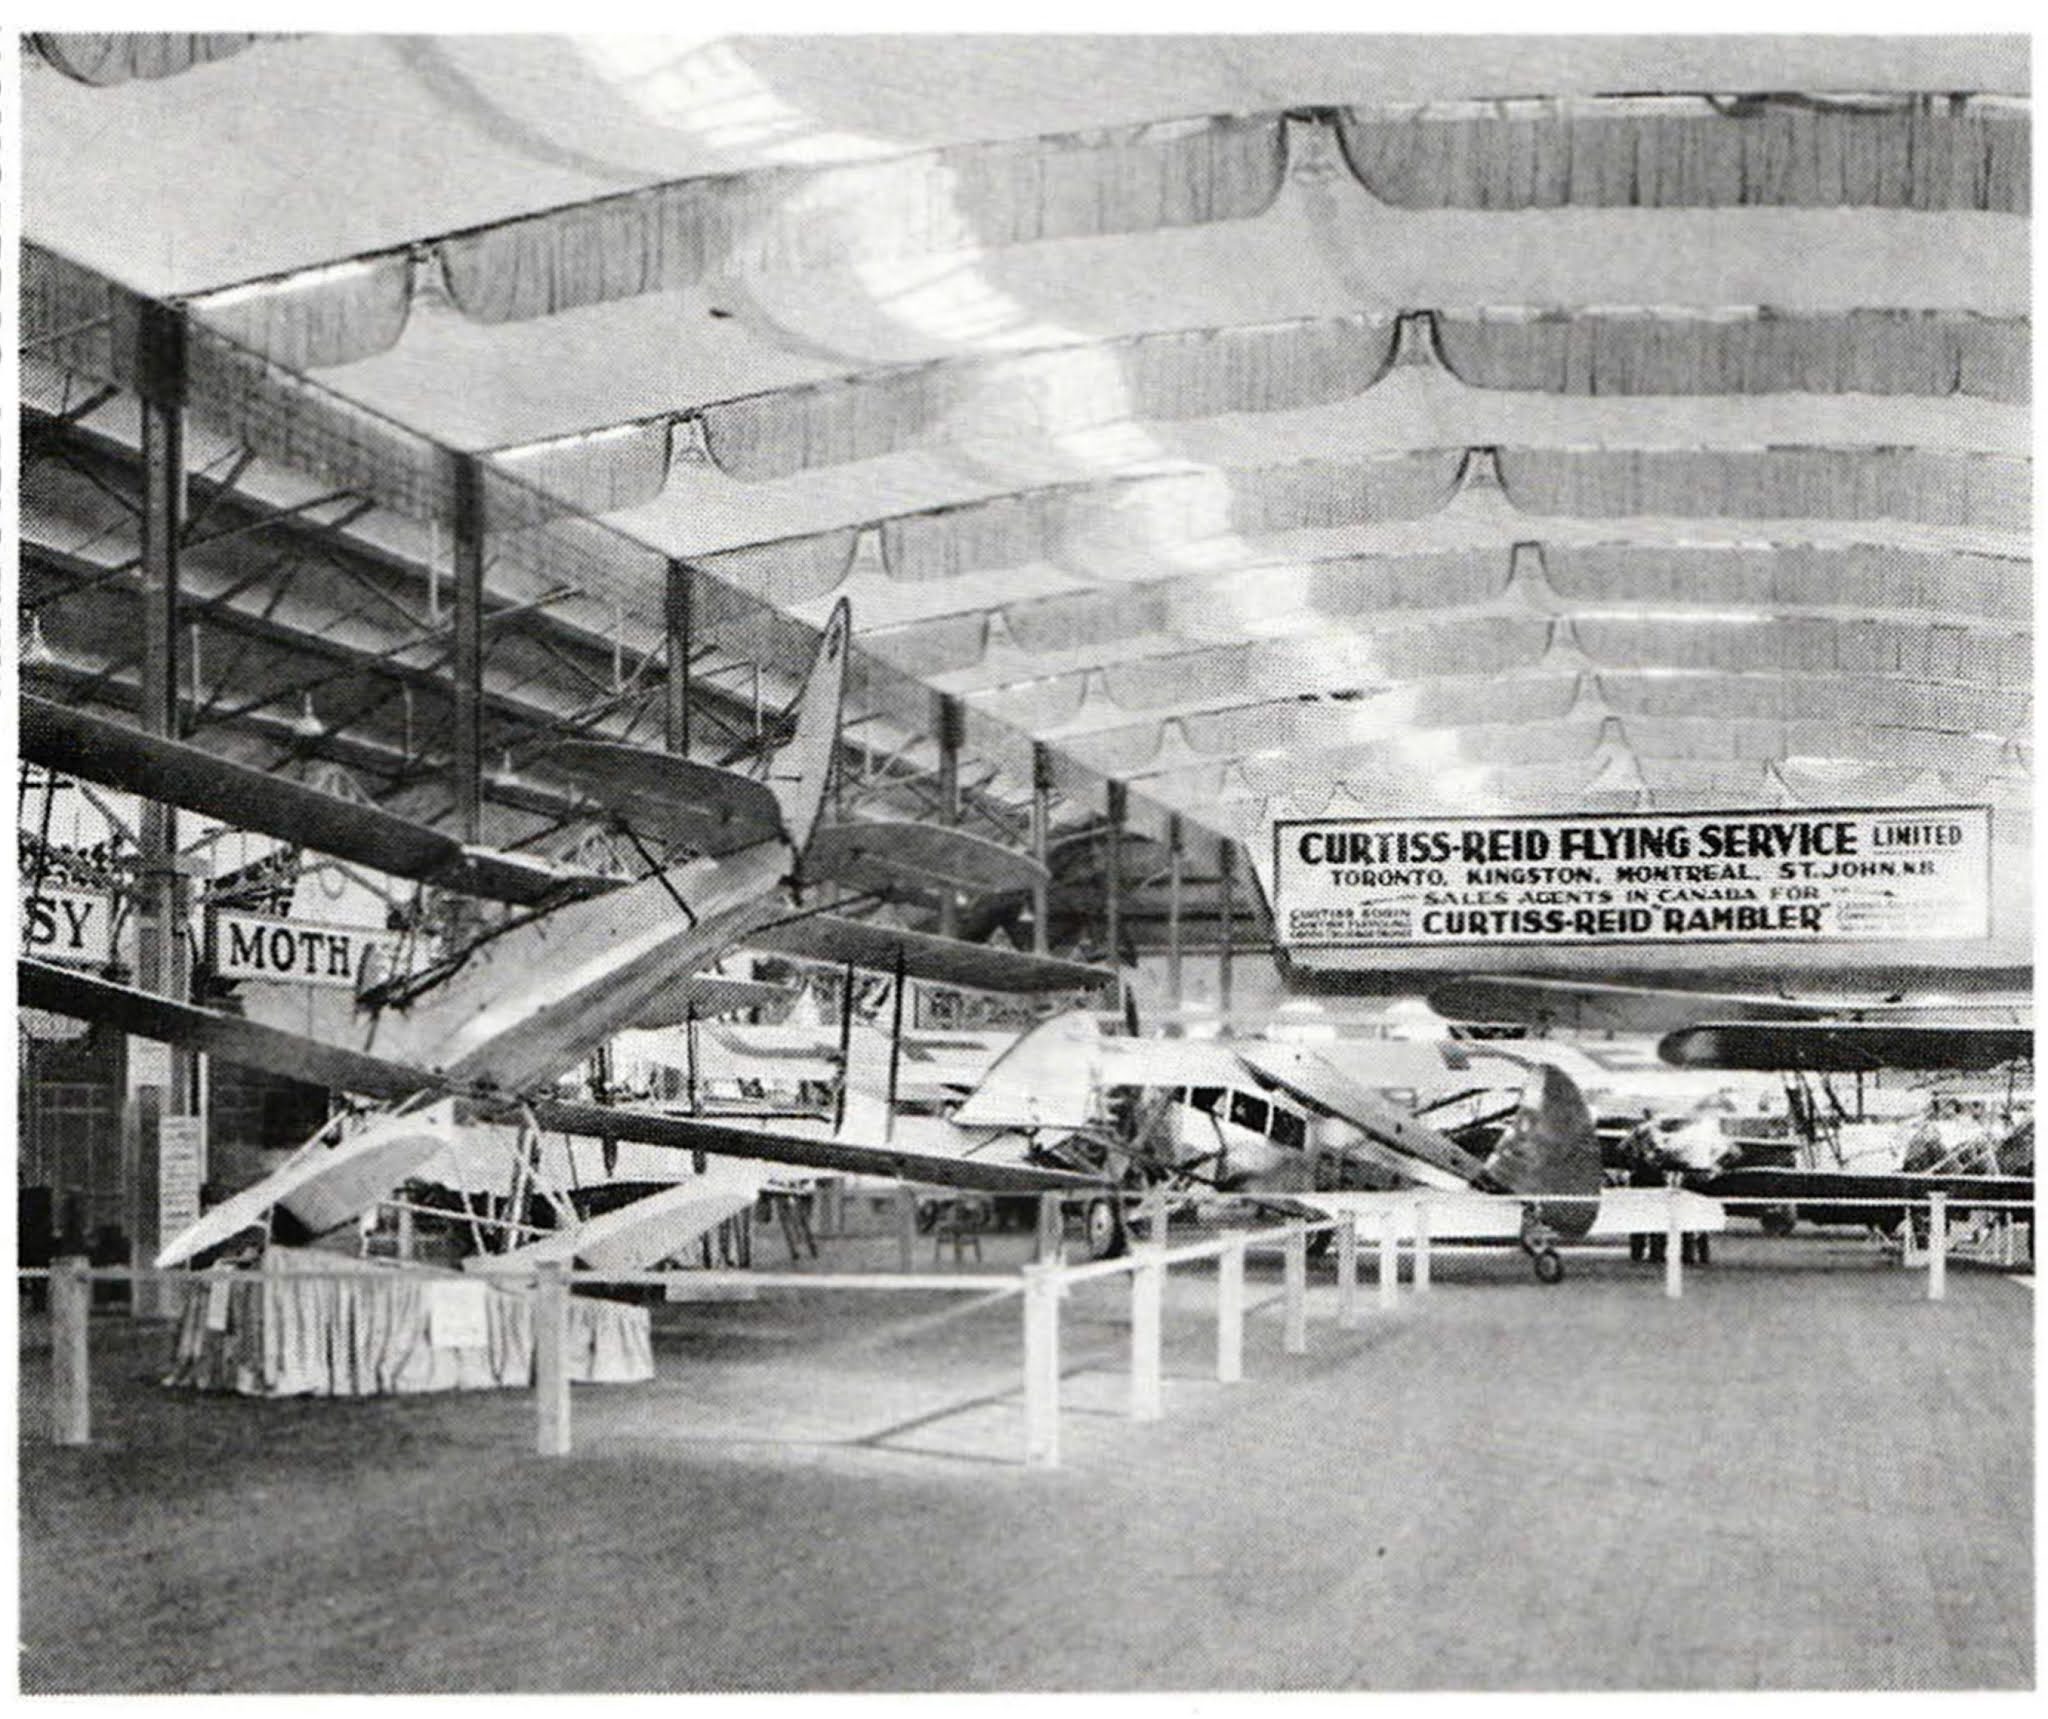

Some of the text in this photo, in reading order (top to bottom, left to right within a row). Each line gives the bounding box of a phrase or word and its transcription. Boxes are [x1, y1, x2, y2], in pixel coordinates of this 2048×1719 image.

[1299, 822, 1962, 865] CURTISS-REID FLYING SERVICE LIMITED
[1423, 886, 1819, 905] SALES AGENTS IN CANADA FOR
[1422, 909, 1651, 935] CURTISS-REID
[229, 922, 350, 976] MOTH
